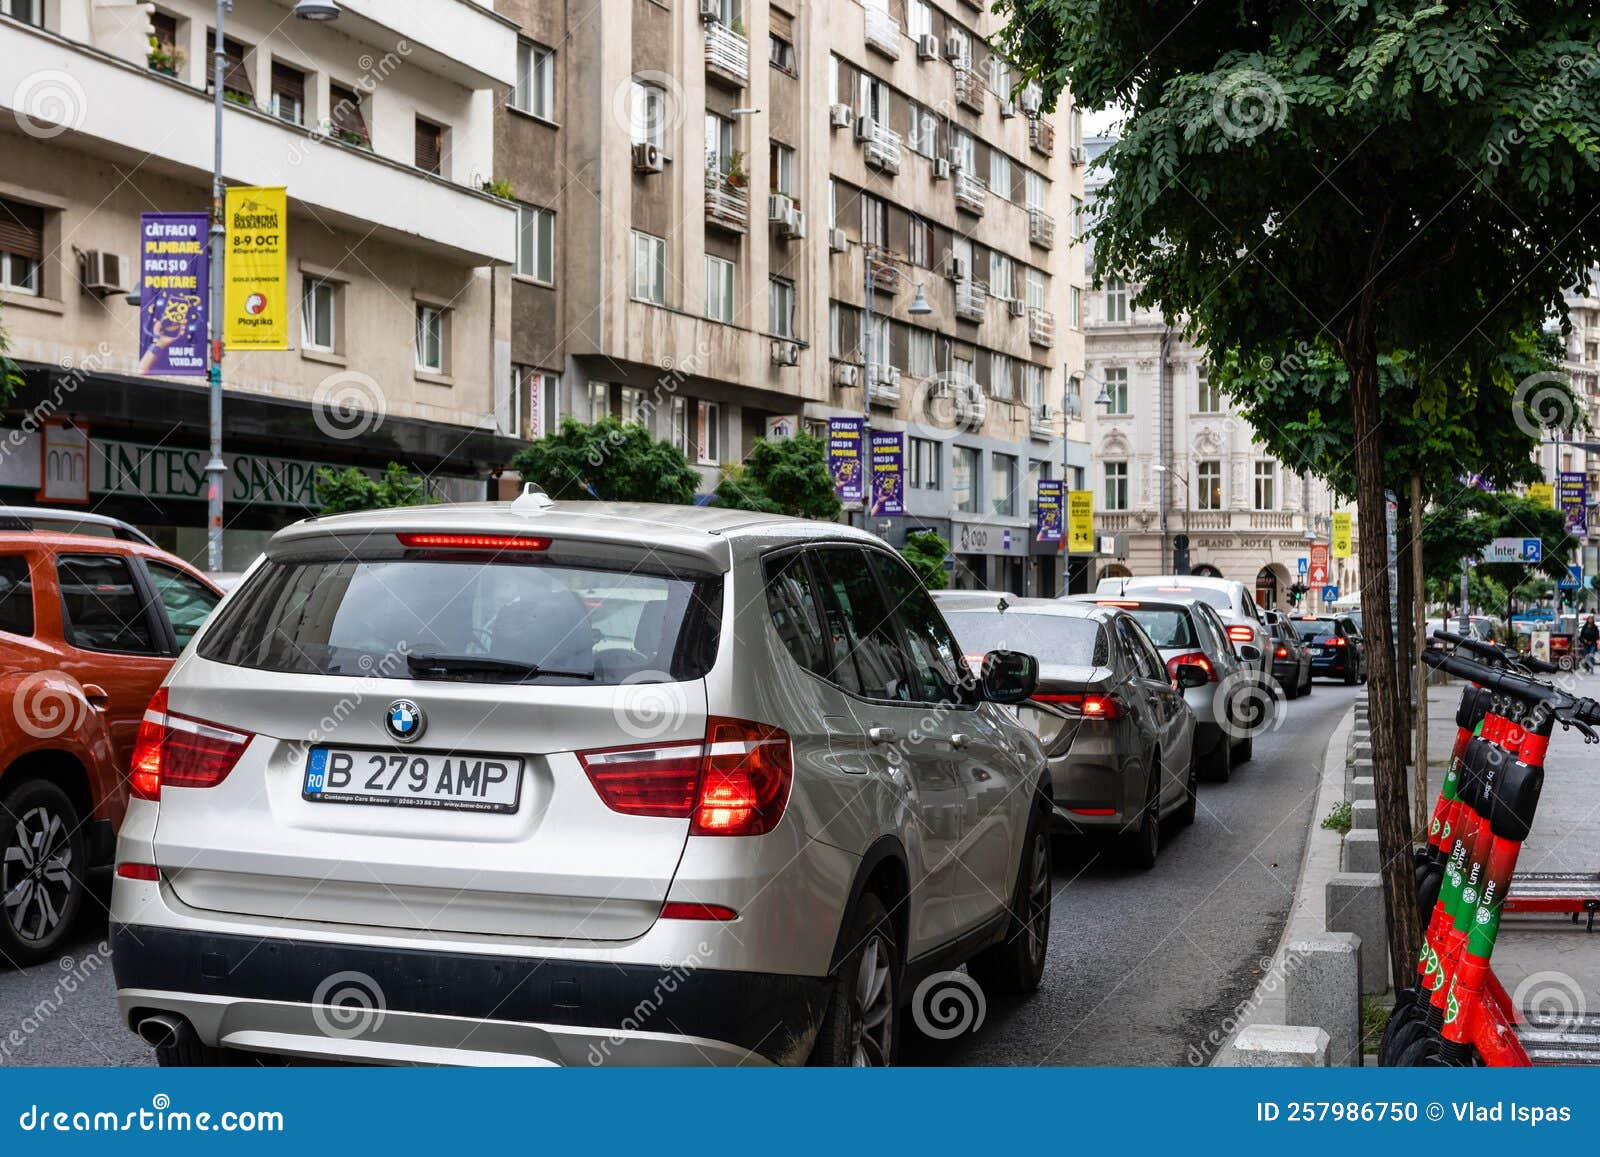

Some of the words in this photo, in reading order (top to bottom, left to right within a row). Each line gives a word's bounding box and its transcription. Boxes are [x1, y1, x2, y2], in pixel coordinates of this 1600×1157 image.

[145, 222, 164, 236] CÂT
[165, 225, 187, 236] FACI
[189, 225, 197, 236] O
[234, 235, 252, 246] 8-9
[255, 235, 279, 246] OCT
[145, 241, 203, 255] PLIMBARE,
[145, 260, 167, 271] FACI
[179, 260, 187, 271] O
[145, 276, 197, 288] PORTARE
[238, 318, 273, 327] Playtika
[169, 347, 183, 356] HAI
[184, 347, 194, 356] PE
[169, 357, 203, 367] YOXO.RO
[1197, 539, 1233, 548] GRAND
[1241, 539, 1272, 548] HOTEL
[1494, 545, 1516, 556] Inter
[327, 753, 354, 788] B
[364, 755, 429, 793] 279
[434, 759, 508, 797] AMP
[308, 774, 323, 788] RO
[354, 795, 368, 803] Cars
[1451, 839, 1463, 860] Lime
[1468, 862, 1480, 885] Lime
[1482, 879, 1496, 905] Lime
